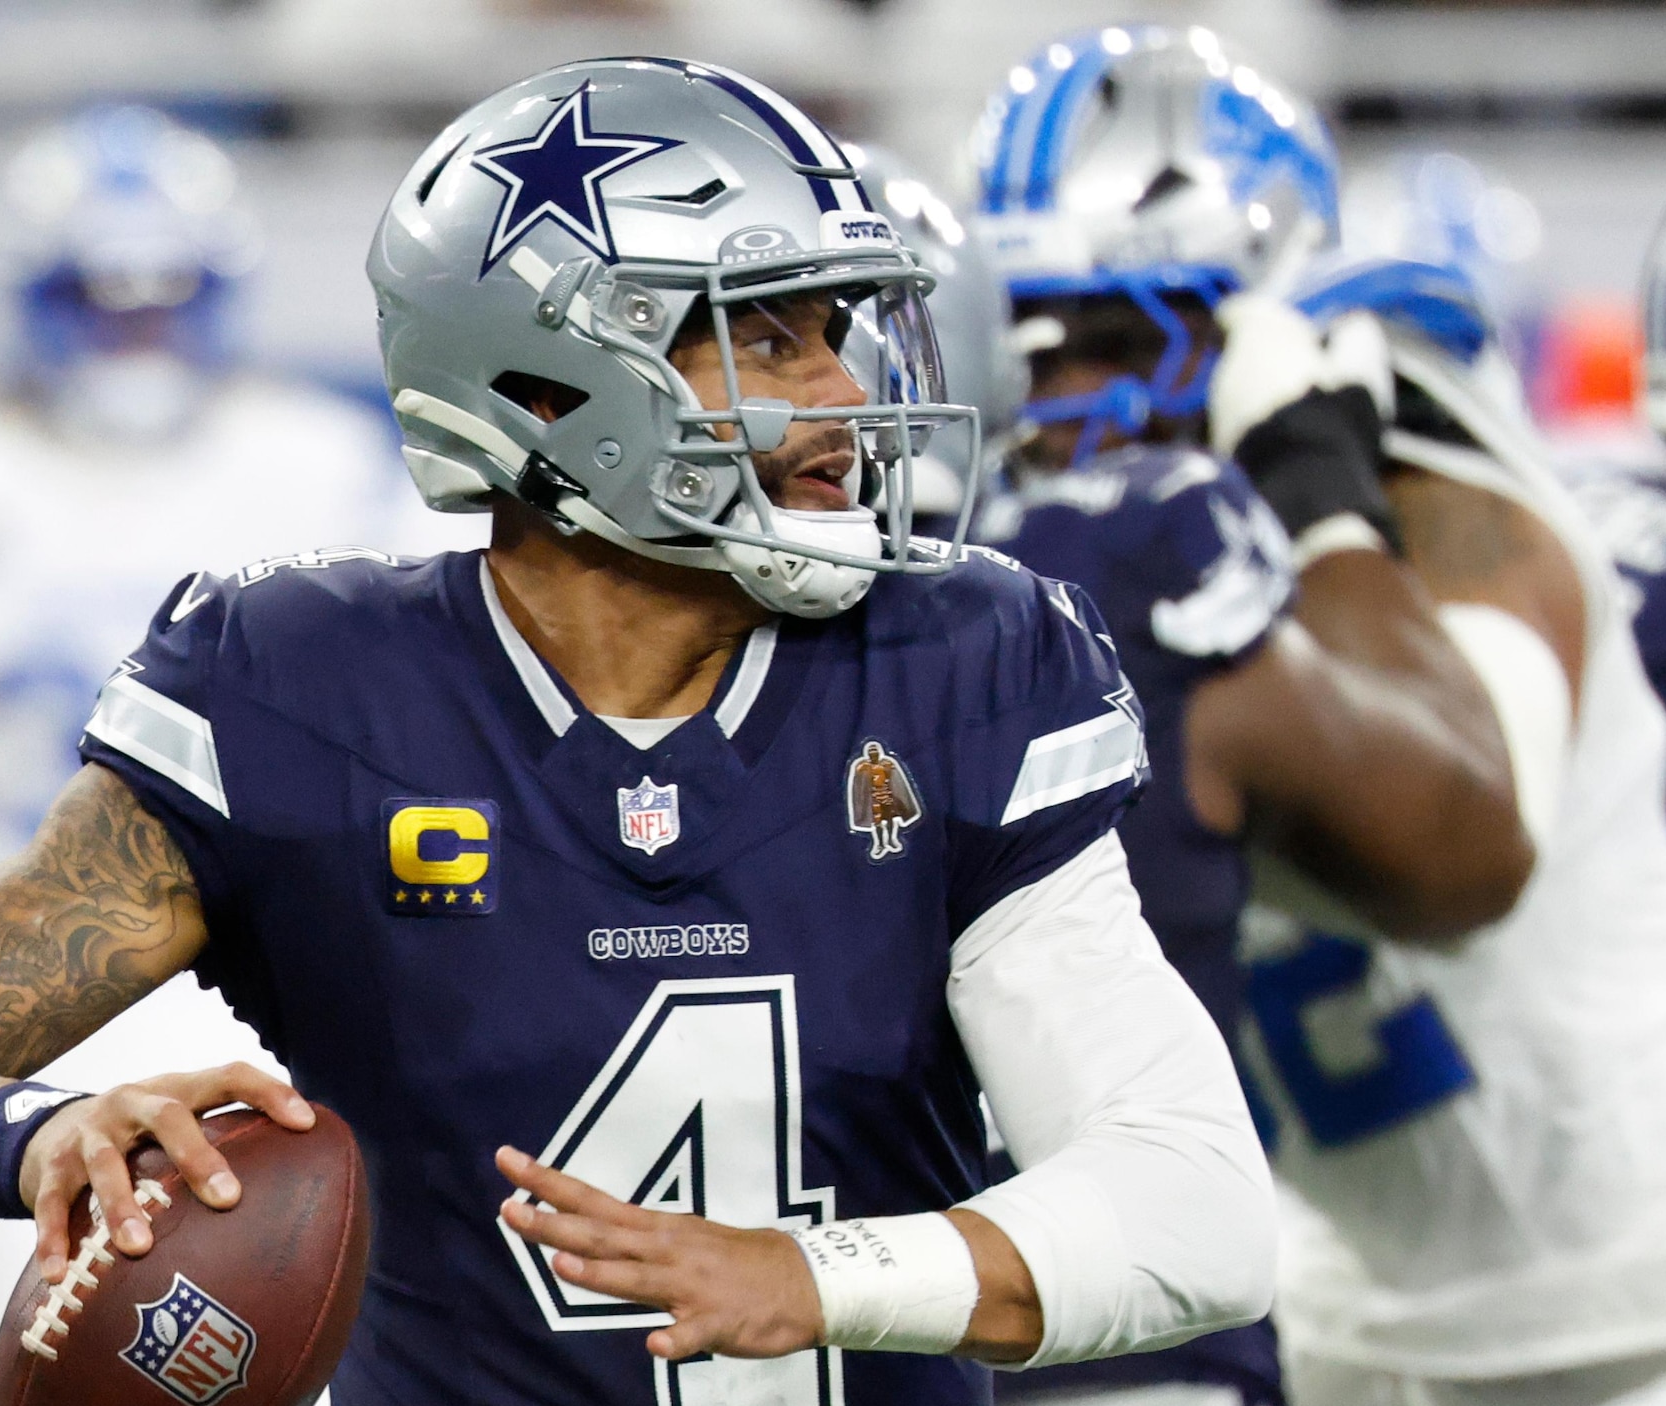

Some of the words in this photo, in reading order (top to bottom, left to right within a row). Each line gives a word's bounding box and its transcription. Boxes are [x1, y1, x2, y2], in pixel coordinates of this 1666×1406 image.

[390, 807, 489, 885] C
[629, 812, 669, 841] NFL
[588, 924, 749, 959] COWBOYS
[164, 1321, 246, 1399] NFL
